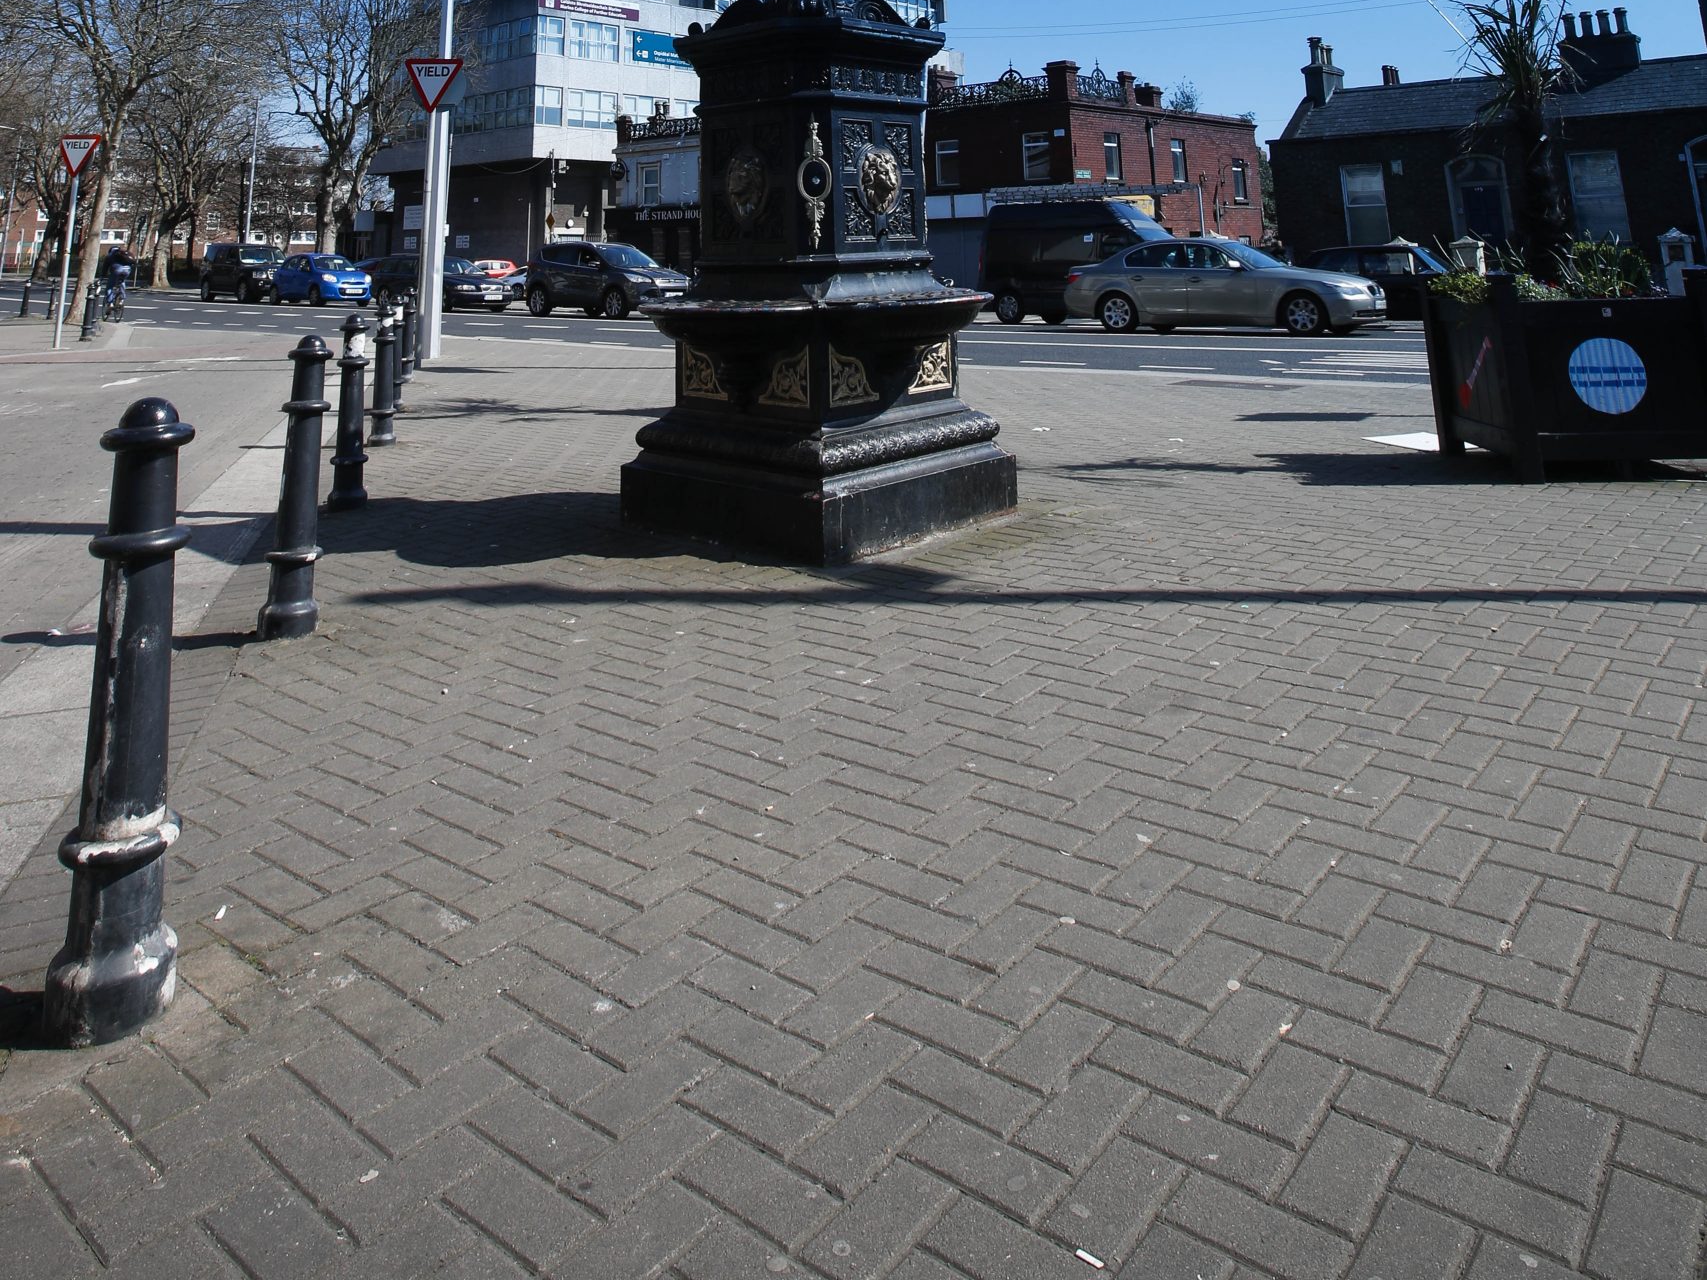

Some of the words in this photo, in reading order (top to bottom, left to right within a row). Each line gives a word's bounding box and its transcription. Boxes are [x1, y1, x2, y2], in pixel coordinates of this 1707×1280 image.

[574, 6, 589, 14] College
[416, 66, 450, 77] YIELD
[65, 141, 90, 149] YIELD
[635, 211, 650, 221] THE
[651, 210, 683, 220] STRAND
[684, 209, 701, 219] HOU
